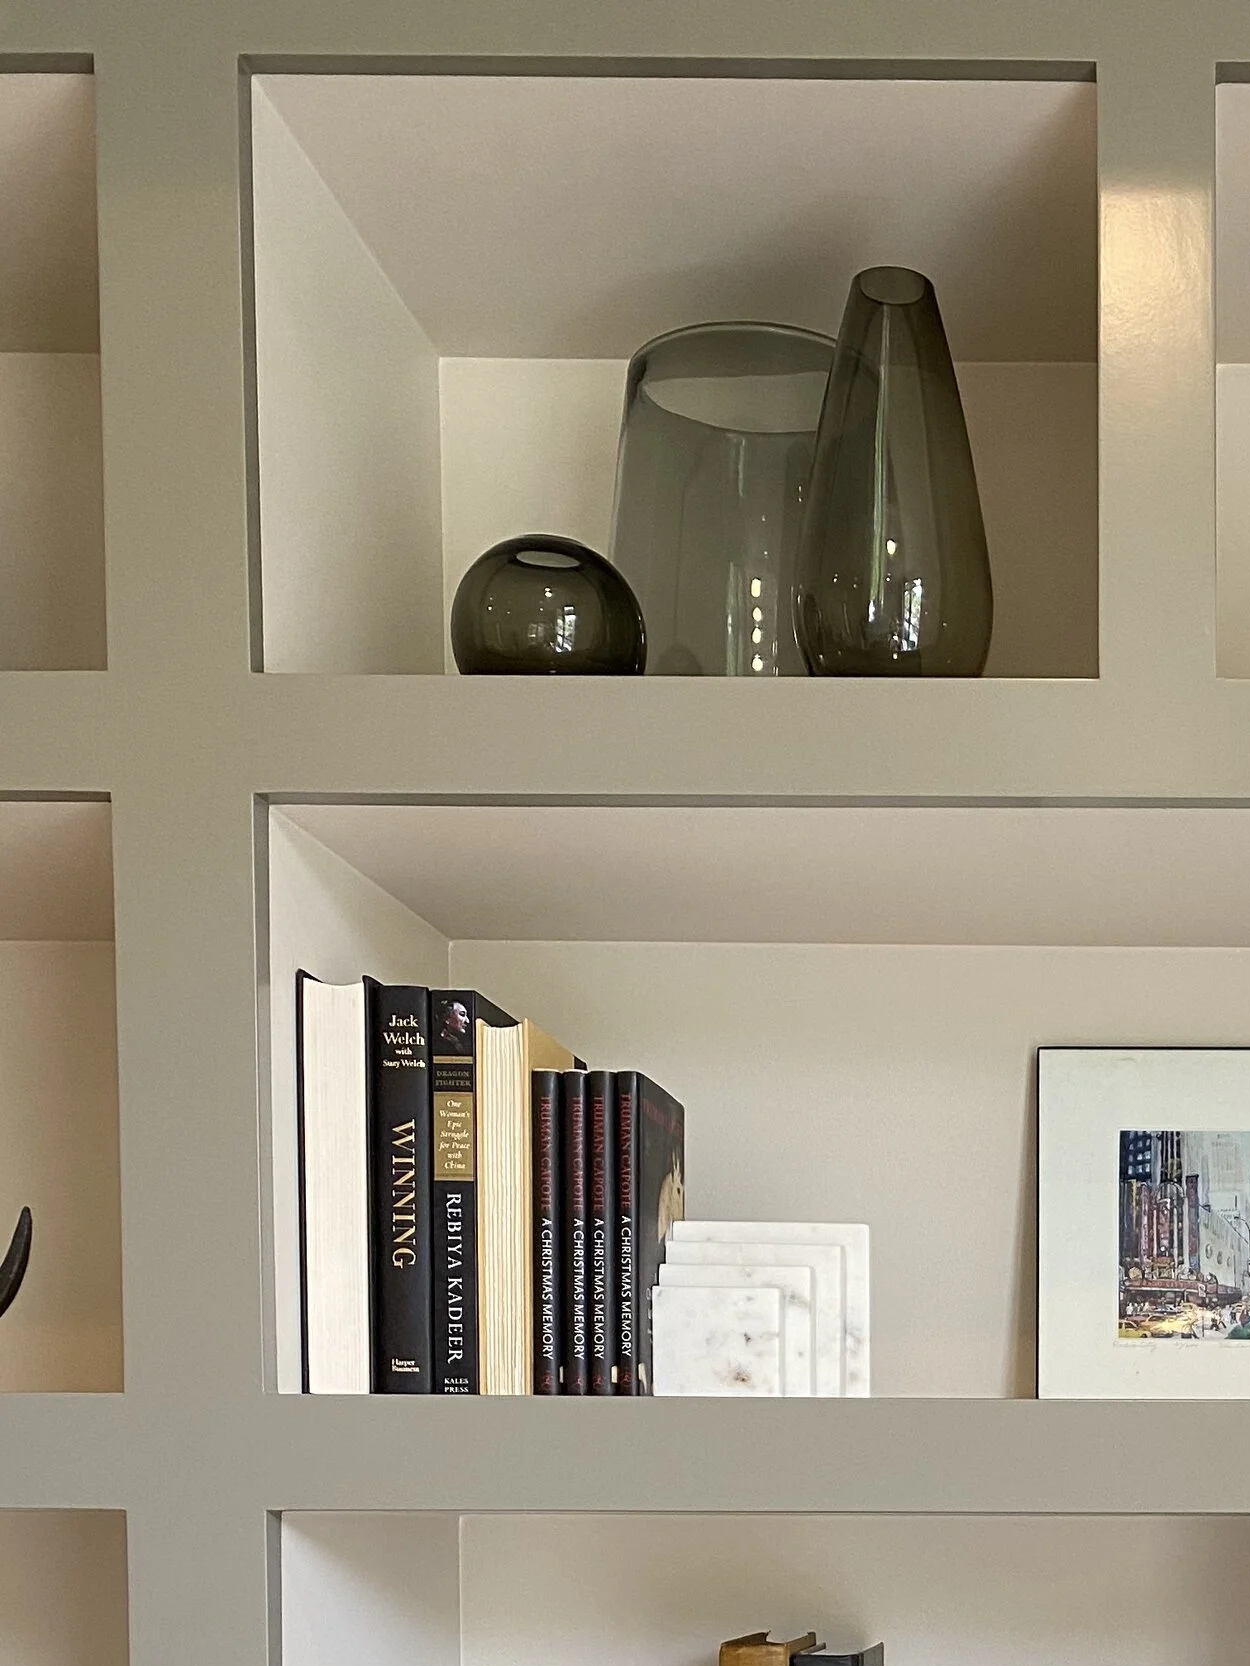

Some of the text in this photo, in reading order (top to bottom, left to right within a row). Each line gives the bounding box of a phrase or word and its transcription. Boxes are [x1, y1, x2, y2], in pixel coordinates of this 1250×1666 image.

[388, 1014, 419, 1028] Jack
[383, 1032, 425, 1046] Welch
[394, 1048, 413, 1056] with
[382, 1058, 426, 1069] Suzy Welch
[435, 1079, 471, 1087] FIGHTER
[446, 1099, 462, 1108] One
[439, 1110, 471, 1118] Woman's
[447, 1120, 462, 1130] Epic
[440, 1131, 469, 1141] Struggle
[438, 1141, 471, 1151] for Peace
[447, 1151, 463, 1159] with
[444, 1160, 466, 1170] China
[391, 1119, 416, 1269] WINNING
[540, 1096, 553, 1360] TRUMAN CAPOTE A CHRISTMAS MEMORY
[572, 1096, 585, 1360] TRUMAN CAPOTE A CHRISTMAS MEMORY
[593, 1096, 605, 1360] TRUMAN CAPOTE A CHRISTMAS MEMORY
[620, 1092, 632, 1357] TRUMAN CAPOTE A CHRISTMAS MEMORY
[446, 1193, 464, 1364] REBIYA KADEER
[444, 1377, 469, 1385] KALES
